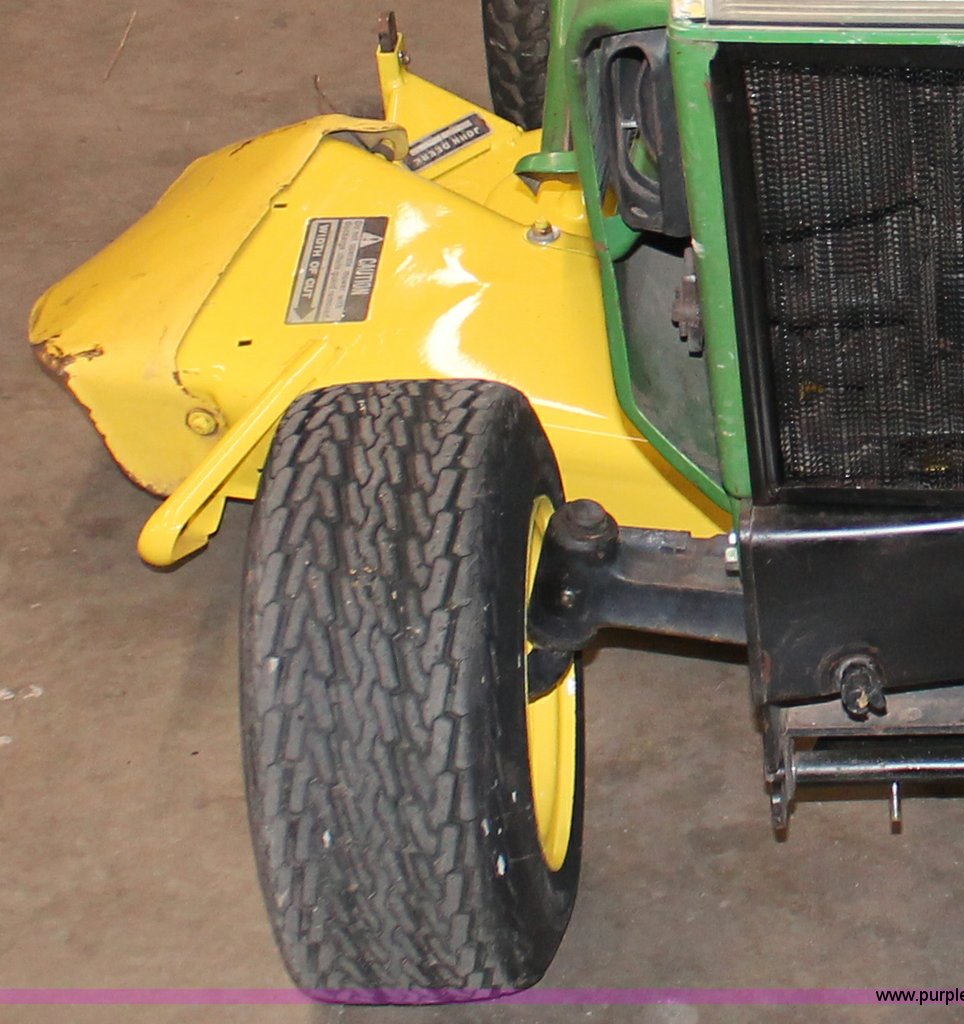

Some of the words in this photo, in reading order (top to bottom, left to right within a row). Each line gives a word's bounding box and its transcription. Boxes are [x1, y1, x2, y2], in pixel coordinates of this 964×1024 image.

[450, 126, 480, 145] JOHN
[312, 223, 330, 258] WIDTH
[308, 261, 320, 275] OF
[302, 278, 315, 299] CUT
